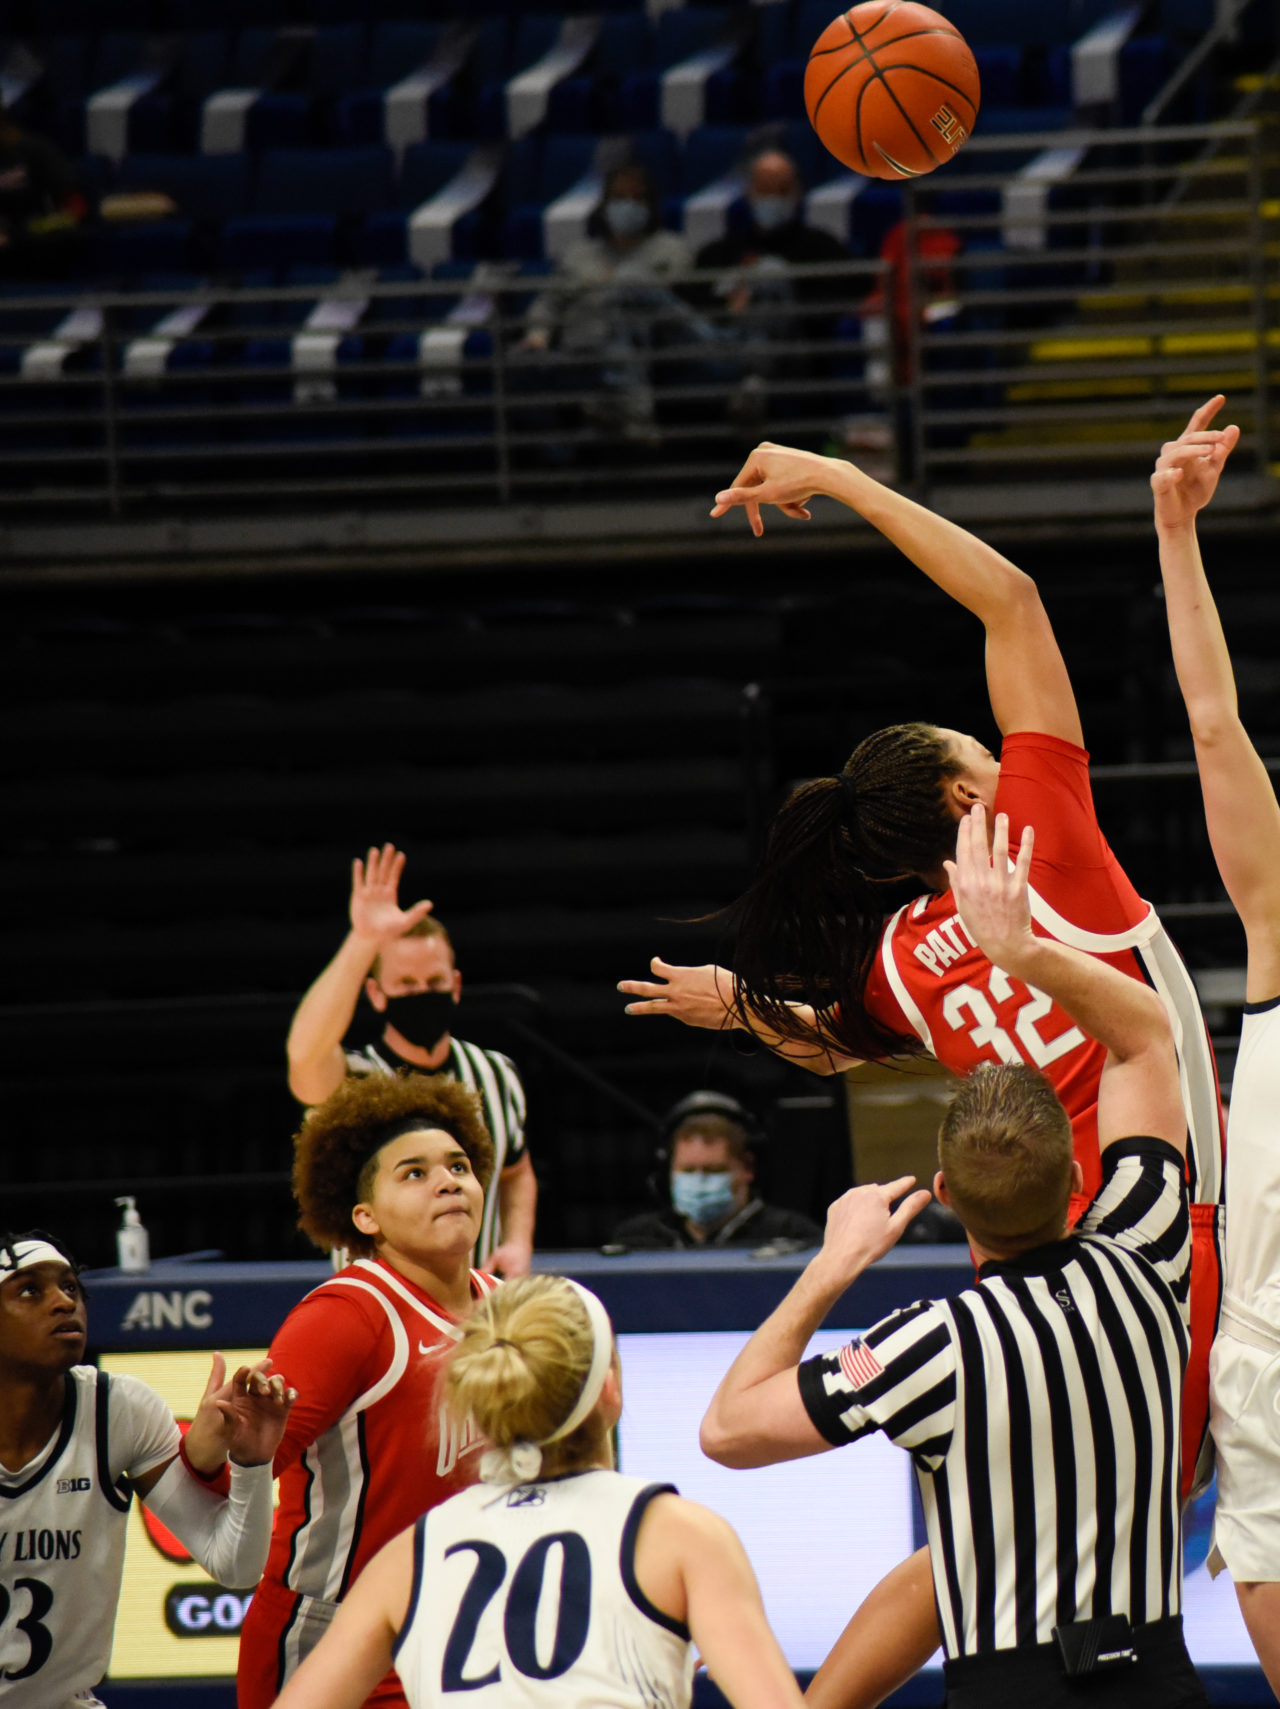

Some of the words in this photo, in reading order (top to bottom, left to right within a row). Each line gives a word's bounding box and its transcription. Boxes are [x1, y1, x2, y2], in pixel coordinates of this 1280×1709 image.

[913, 913, 978, 978] PATT
[943, 957, 1087, 1069] 32
[121, 1289, 214, 1330] ANC
[13, 1529, 83, 1562] LIONS
[0, 1577, 54, 1682] 3
[441, 1530, 592, 1693] 20
